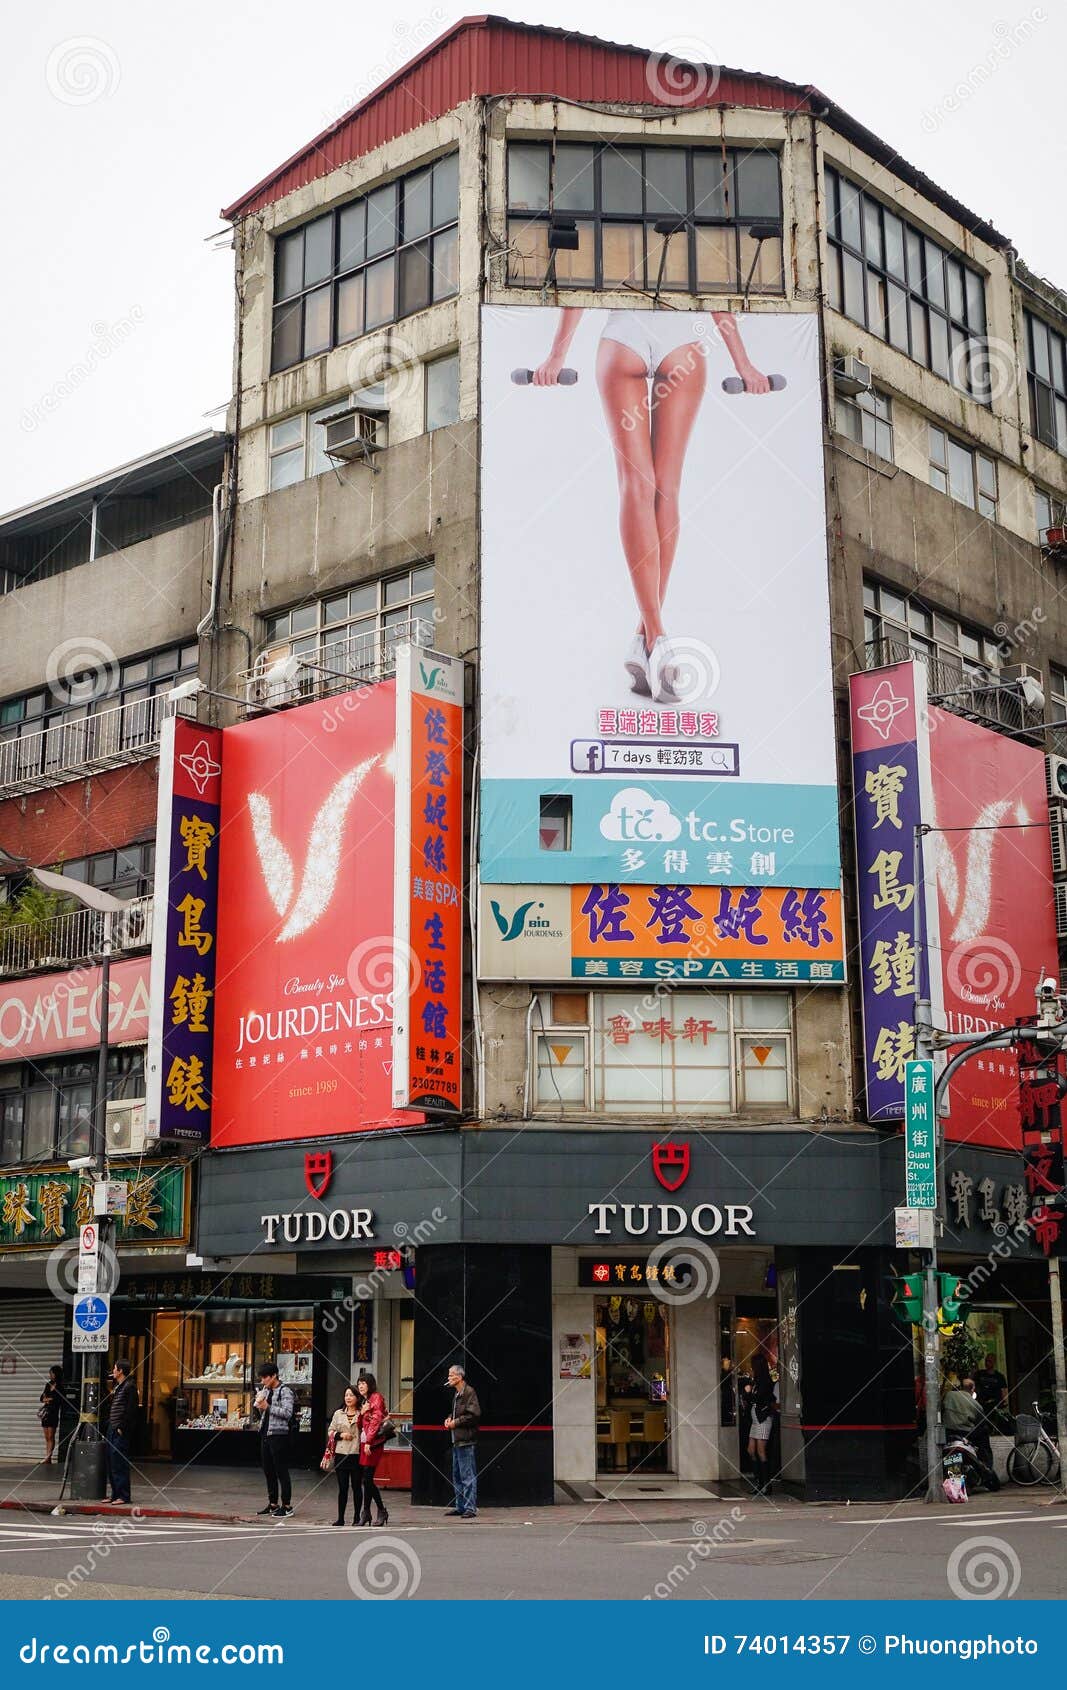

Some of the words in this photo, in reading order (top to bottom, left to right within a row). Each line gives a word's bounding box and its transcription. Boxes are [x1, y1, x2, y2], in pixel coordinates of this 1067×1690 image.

[599, 709, 719, 736] 雲端控重專家
[612, 750, 620, 762] 7
[623, 750, 652, 765] days
[423, 708, 451, 874] 佐登妮絲
[620, 849, 776, 876] 多得雲創
[413, 876, 459, 907] 美容SPA
[580, 883, 834, 949] 佐登妮絲
[523, 929, 563, 938] JOURDENESS
[166, 814, 216, 1112] 寶島鐘錶
[421, 912, 449, 1039] 生活館
[585, 959, 833, 978] 美容SPA生活館
[284, 976, 325, 997] Beauty
[328, 974, 345, 993] Spa
[961, 984, 991, 1011] Beauty
[0, 976, 150, 1048] OMEGA
[415, 1046, 455, 1066] 桂林店
[288, 1084, 313, 1098] since
[315, 1079, 338, 1095] 1989
[412, 1076, 458, 1094] 23027789
[911, 1076, 928, 1148] 廣州街
[971, 1096, 989, 1108] since
[908, 1151, 930, 1159] Guan
[908, 1162, 930, 1170] Zhou
[261, 1209, 374, 1244] TUDOR
[588, 1203, 757, 1236] TUDOR
[74, 1334, 108, 1343] 行人優先
